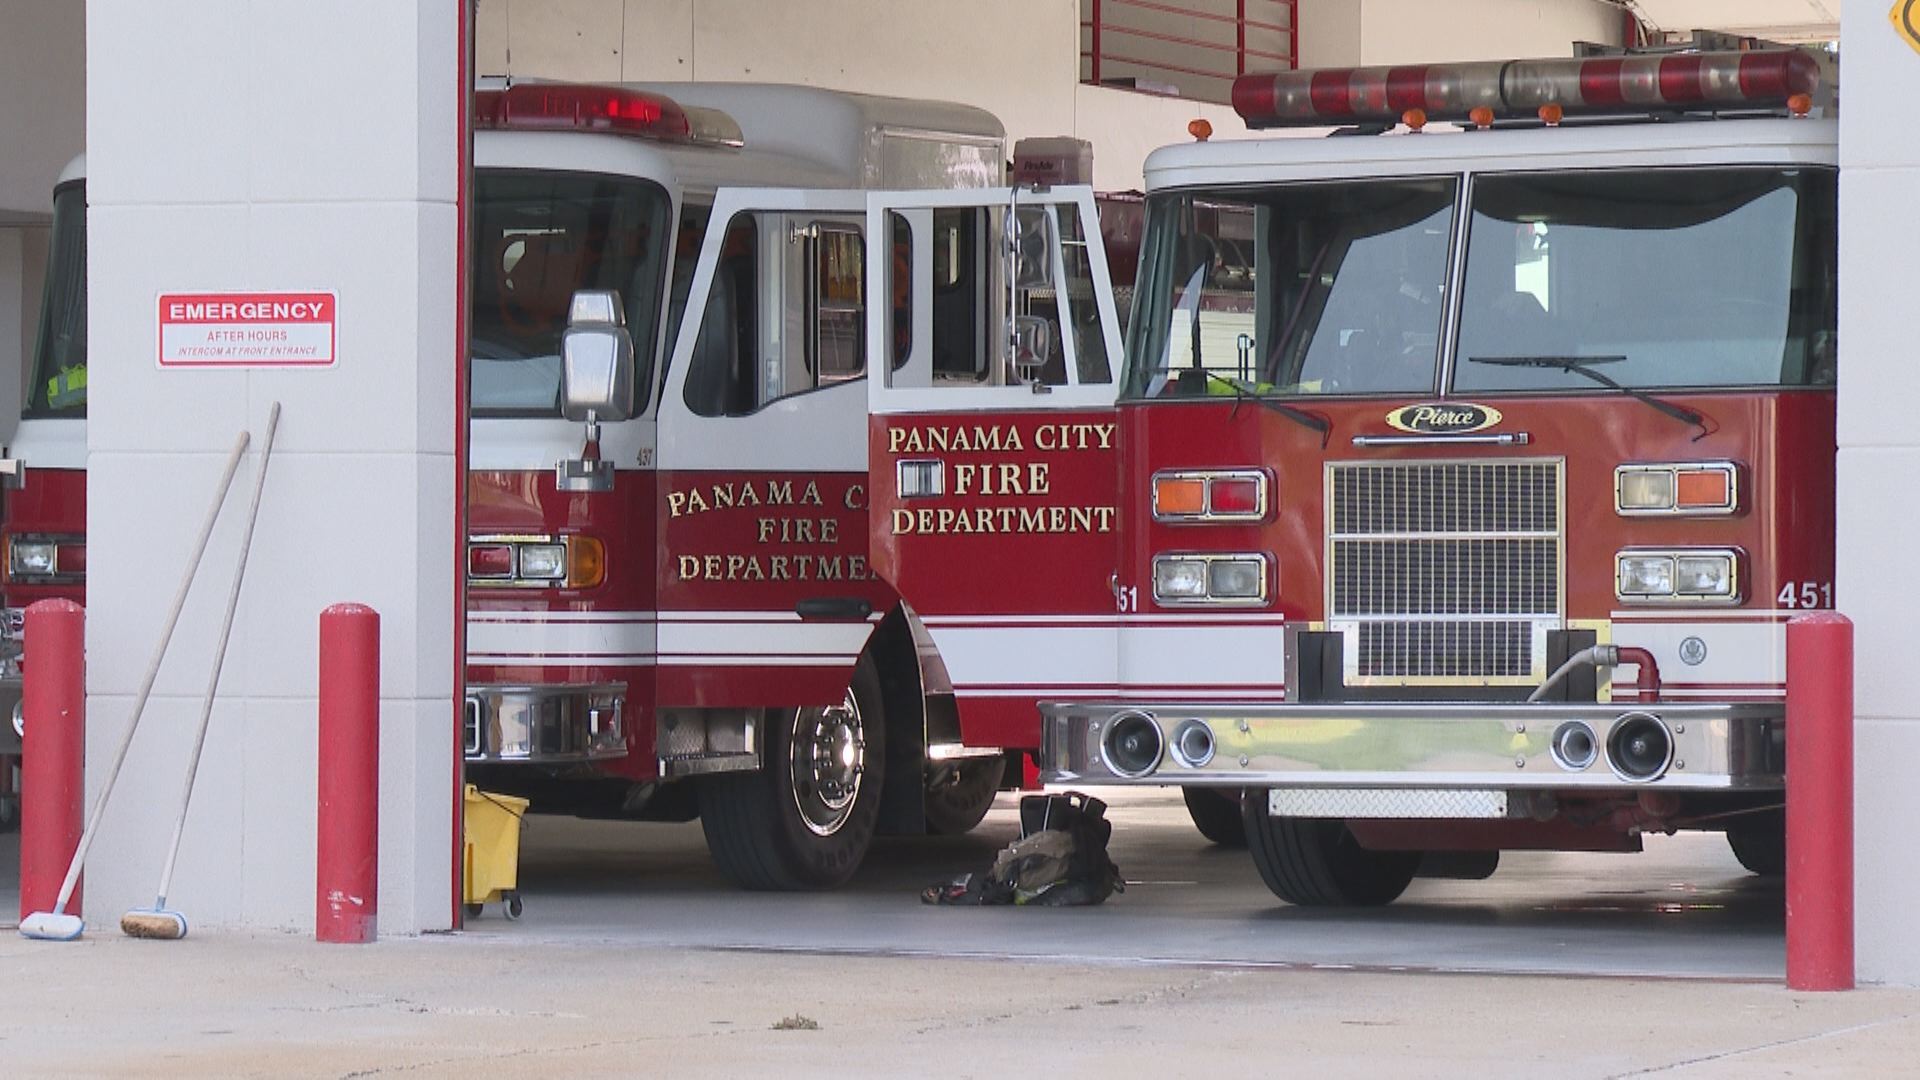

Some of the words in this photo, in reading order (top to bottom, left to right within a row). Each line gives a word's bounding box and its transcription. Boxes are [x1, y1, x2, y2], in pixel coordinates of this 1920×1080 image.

[169, 302, 323, 319] EMERGENCY
[207, 331, 244, 342] AFTER
[249, 330, 288, 342] HOURS
[178, 346, 223, 356] INTERCOM
[225, 346, 237, 356] AT
[238, 346, 268, 356] FRONT
[270, 345, 317, 355] ENTRANCE
[1411, 406, 1475, 429] Pierce
[888, 424, 1024, 452] PANAMA
[1035, 423, 1115, 449] CITY
[636, 447, 653, 466] 437
[954, 462, 1049, 495] FIRE
[666, 479, 823, 518] PANAMA
[758, 518, 839, 543] FIRE
[891, 506, 1115, 535] DEPARTMENT
[1116, 585, 1137, 612] 51
[1778, 582, 1832, 609] 451
